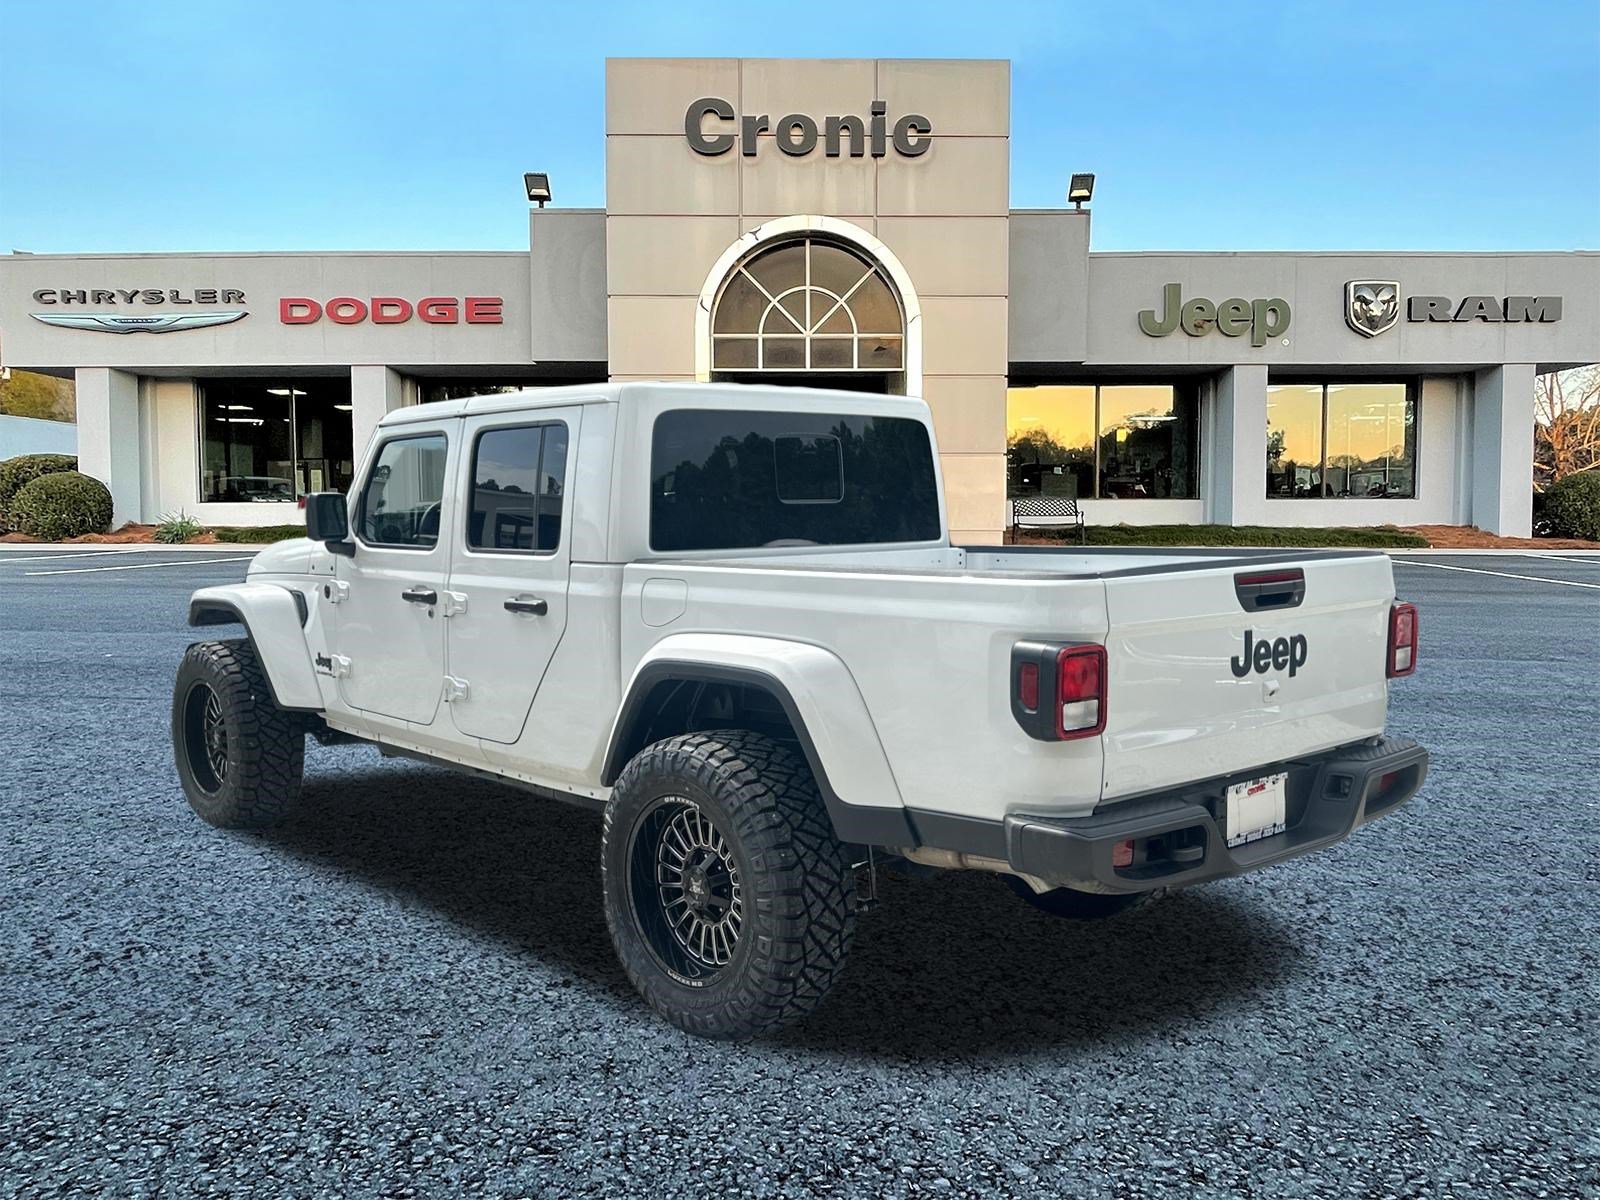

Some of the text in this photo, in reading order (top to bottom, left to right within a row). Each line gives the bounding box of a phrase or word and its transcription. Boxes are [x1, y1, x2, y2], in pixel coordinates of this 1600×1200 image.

[684, 97, 933, 158] Cronic
[32, 287, 248, 306] CHRYSLER
[279, 296, 504, 325] DODGE
[1406, 295, 1563, 323] RAM
[1138, 282, 1292, 347] Jeep
[315, 652, 332, 671] Jeep
[1230, 629, 1308, 679] Jeep
